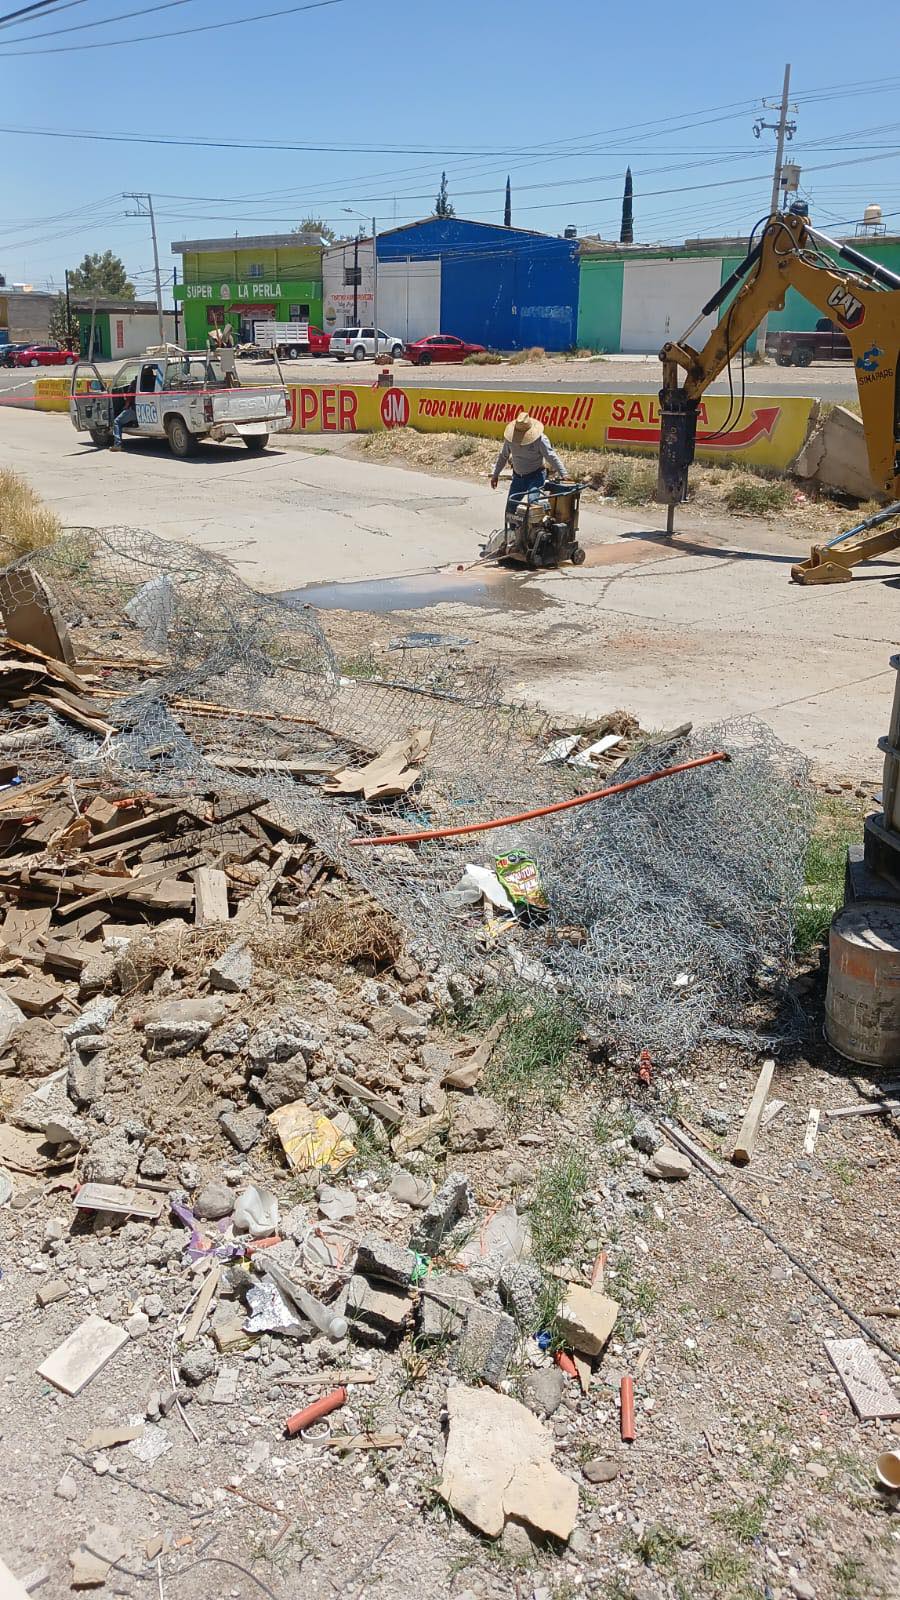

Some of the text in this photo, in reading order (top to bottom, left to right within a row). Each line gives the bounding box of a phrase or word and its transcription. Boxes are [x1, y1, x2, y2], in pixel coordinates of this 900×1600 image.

[186, 284, 282, 298] SUPER LA PERLA
[828, 285, 863, 320] CAT
[384, 394, 405, 422] JM
[418, 399, 446, 417] TODO
[448, 401, 463, 418] EN
[464, 402, 481, 420] UN
[483, 402, 524, 422] MISMO
[612, 399, 708, 425] SALA
